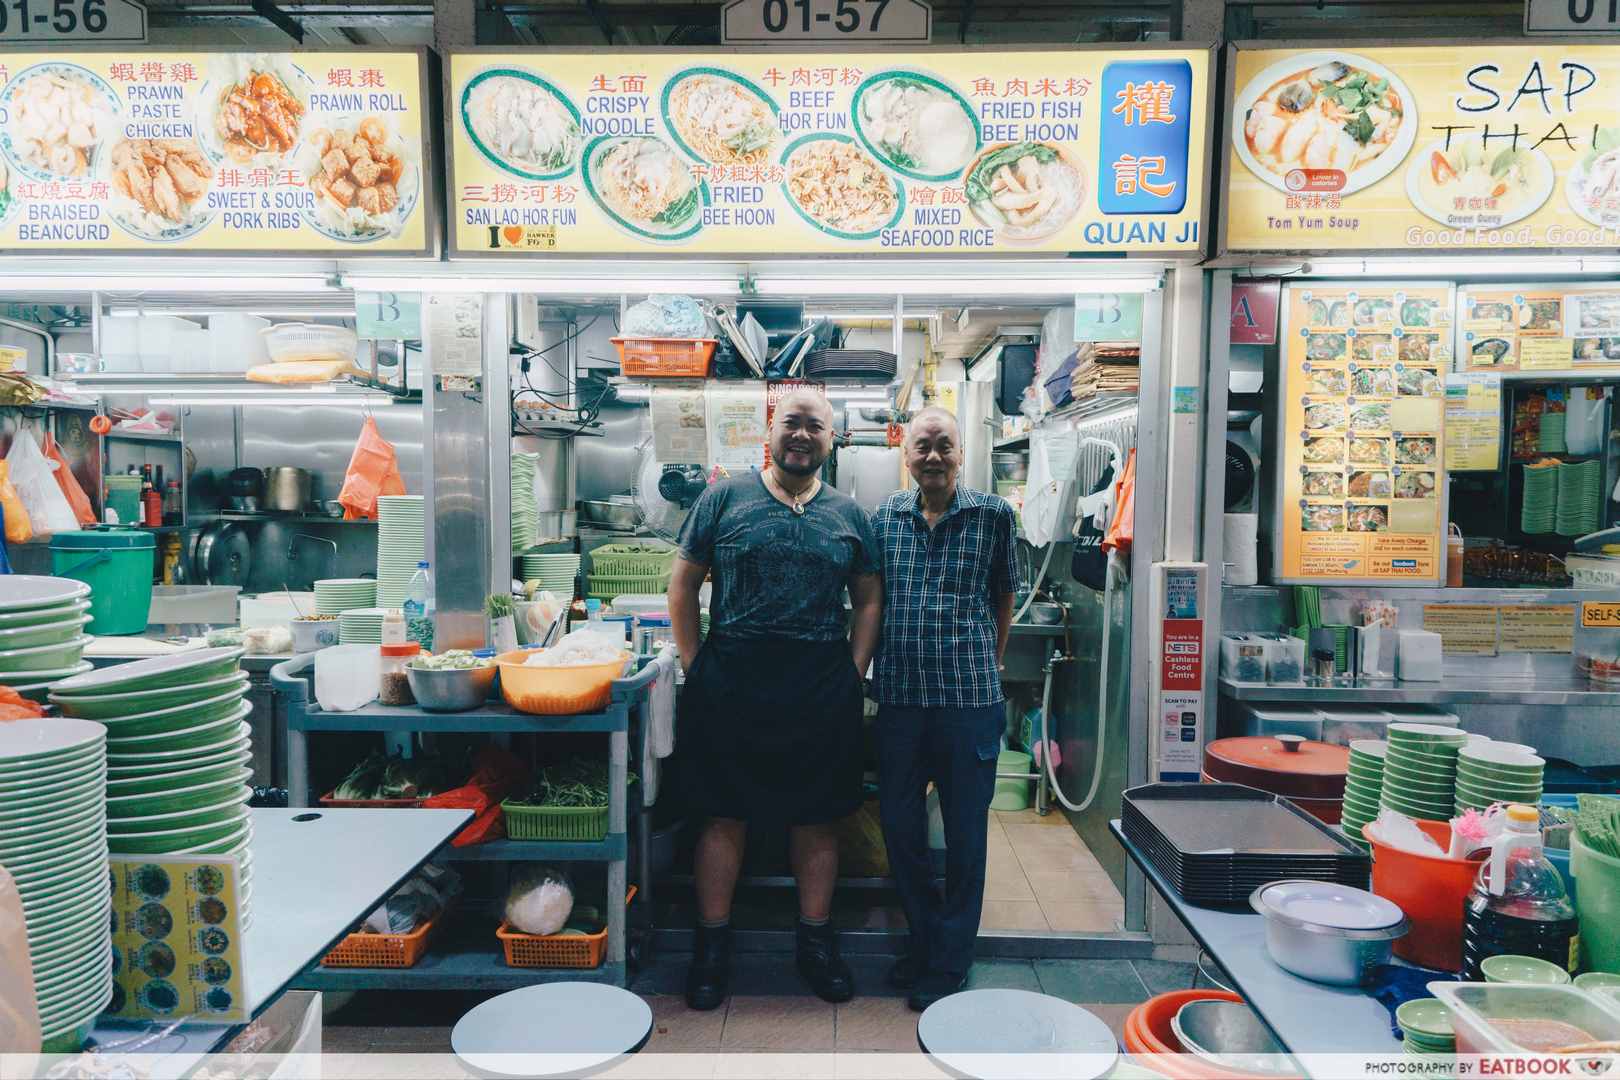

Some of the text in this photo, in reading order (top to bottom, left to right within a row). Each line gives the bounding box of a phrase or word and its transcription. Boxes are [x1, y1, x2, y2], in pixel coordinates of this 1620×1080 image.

[762, 0, 887, 33] 01-57
[588, 74, 648, 94] 生面
[762, 67, 864, 87] 牛肉河粉
[127, 85, 184, 101] PRAWN
[970, 77, 1093, 98] 魚肉米粉
[1456, 61, 1597, 114] SAP
[311, 94, 408, 112] PRAWN ROLL
[586, 96, 650, 114] CRISPY
[790, 91, 835, 107] BEEF
[132, 104, 182, 118] PASTE
[981, 102, 1082, 119] FRIED FISH
[582, 118, 656, 135] NOODLE
[779, 112, 847, 129] HOR FUN
[125, 123, 193, 138] CHICKEN
[982, 124, 1079, 141] BEE HOON
[1432, 122, 1600, 152] THAI
[1112, 80, 1177, 199] 權記
[217, 167, 305, 188] 排骨王
[17, 182, 110, 201] 紅燒豆腐
[207, 191, 315, 208] SWEET & SOUR
[713, 186, 764, 203] FRIED
[28, 204, 100, 221] BRAISED
[223, 212, 301, 229] PORK RIBS
[466, 207, 577, 225] SAN LAO HOR FUN
[703, 208, 775, 225] BEE HOON
[914, 207, 961, 225] MIXED
[19, 224, 110, 240] BEANCURD
[1267, 216, 1360, 231] Tom Yum Soup
[881, 229, 994, 247] SEAFOOD RICE
[1084, 222, 1198, 246] QUAN JI
[1407, 226, 1466, 245] Good
[1546, 225, 1606, 245] Good
[376, 291, 401, 321] B
[1231, 293, 1260, 328] A
[1168, 643, 1199, 652] NETS
[1168, 671, 1196, 679] Centre
[1171, 663, 1192, 671] Food
